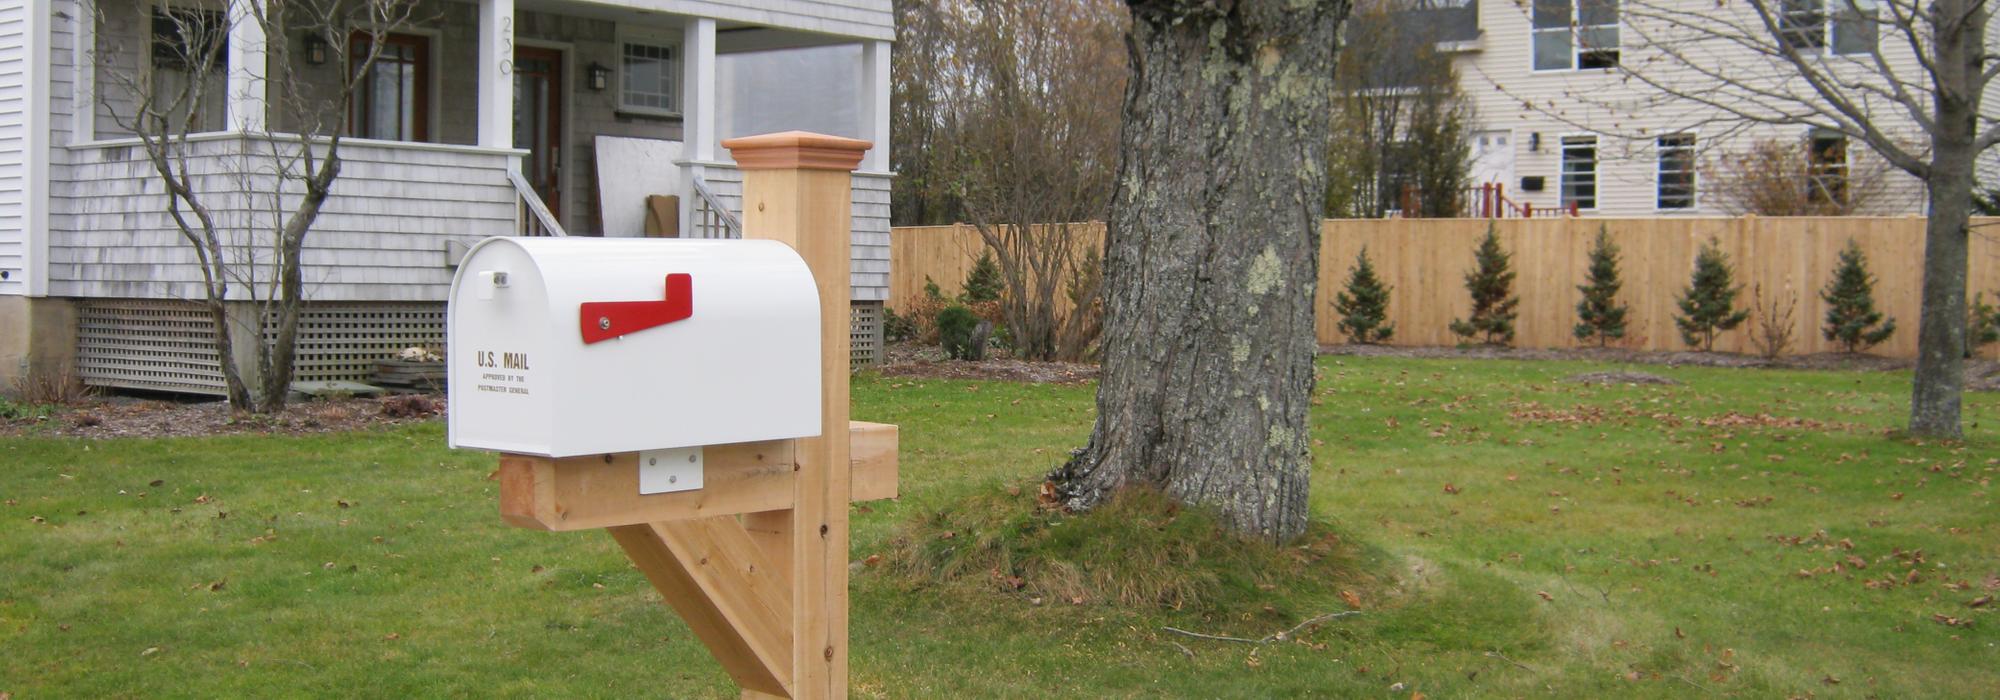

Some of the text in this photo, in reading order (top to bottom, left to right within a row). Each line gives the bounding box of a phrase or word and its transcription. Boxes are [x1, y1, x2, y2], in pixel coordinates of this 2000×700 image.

[477, 350, 529, 370] U.S. MAIL
[482, 372, 506, 382] APPROVED
[516, 375, 525, 383] THE
[477, 384, 529, 395] POSTMASTER GENERAL
